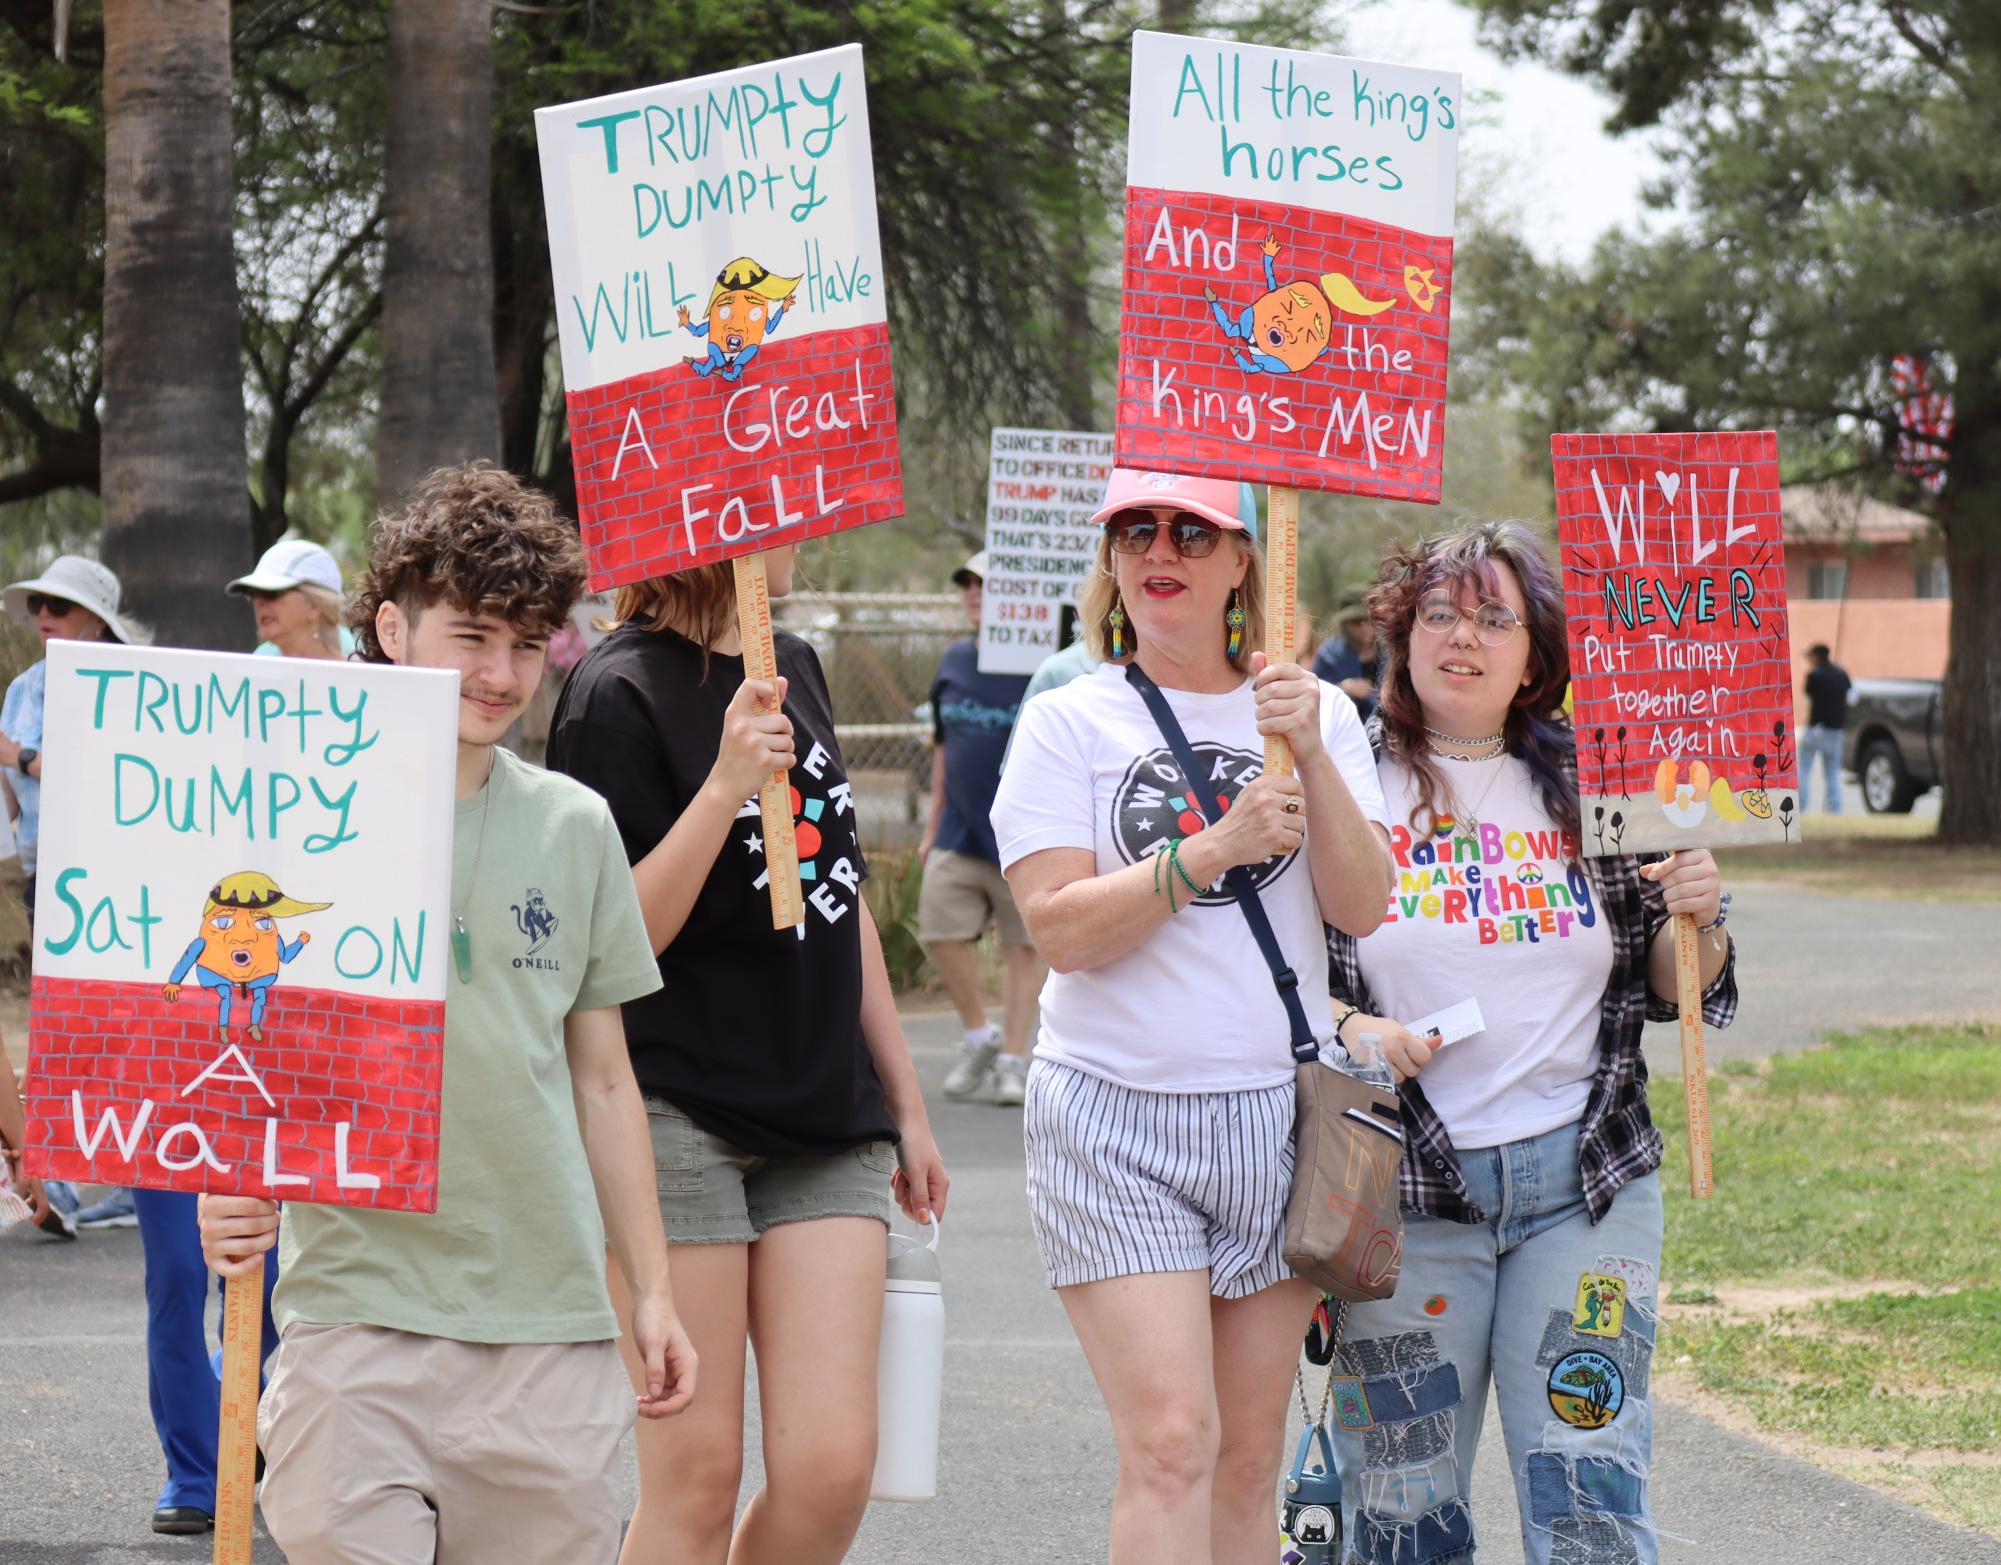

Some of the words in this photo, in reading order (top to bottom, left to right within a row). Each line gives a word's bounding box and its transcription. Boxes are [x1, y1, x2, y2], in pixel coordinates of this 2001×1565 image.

[1172, 53, 1240, 123] All
[1261, 59, 1334, 119] the
[1353, 69, 1456, 142] King's
[1220, 123, 1404, 191] horses
[1145, 207, 1239, 271] And
[1341, 324, 1413, 373] the
[611, 406, 658, 481] A
[723, 357, 875, 453] Great
[1152, 359, 1297, 441] King's
[995, 434, 1053, 453] SINCE
[992, 458, 1018, 476] TO
[1022, 460, 1086, 479] OFFICE
[994, 480, 1057, 502] TRUMP
[1061, 487, 1098, 504] HAS
[1021, 508, 1066, 526] DAYS
[992, 530, 1052, 550] THAT'S
[1285, 518, 1297, 569] DEPOT
[989, 553, 1092, 575] PRESIDENC
[755, 576, 768, 627] DEPOT
[987, 577, 1038, 598] COST
[1042, 581, 1067, 598] OF
[1284, 572, 1296, 618] HOME
[1604, 567, 1760, 633] NEVER
[760, 633, 774, 679] HOME
[987, 625, 1011, 644] TO
[1016, 627, 1054, 646] TAX
[1284, 620, 1295, 650] THE
[1584, 635, 1632, 674] Put
[1648, 634, 1739, 677] Trumpty
[1608, 682, 1731, 719] together
[1648, 718, 1740, 761] Again
[44, 867, 163, 970] Sat
[333, 910, 426, 984] ON
[1680, 924, 1689, 967] PAINTS
[512, 957, 560, 971] O'NEILL
[181, 1044, 275, 1108] A
[1692, 1128, 1700, 1146] 269
[228, 1290, 240, 1342] PAINTS
[1566, 1355, 1582, 1367] DIVE
[1588, 1355, 1602, 1365] BAY
[1602, 1362, 1617, 1379] AREA
